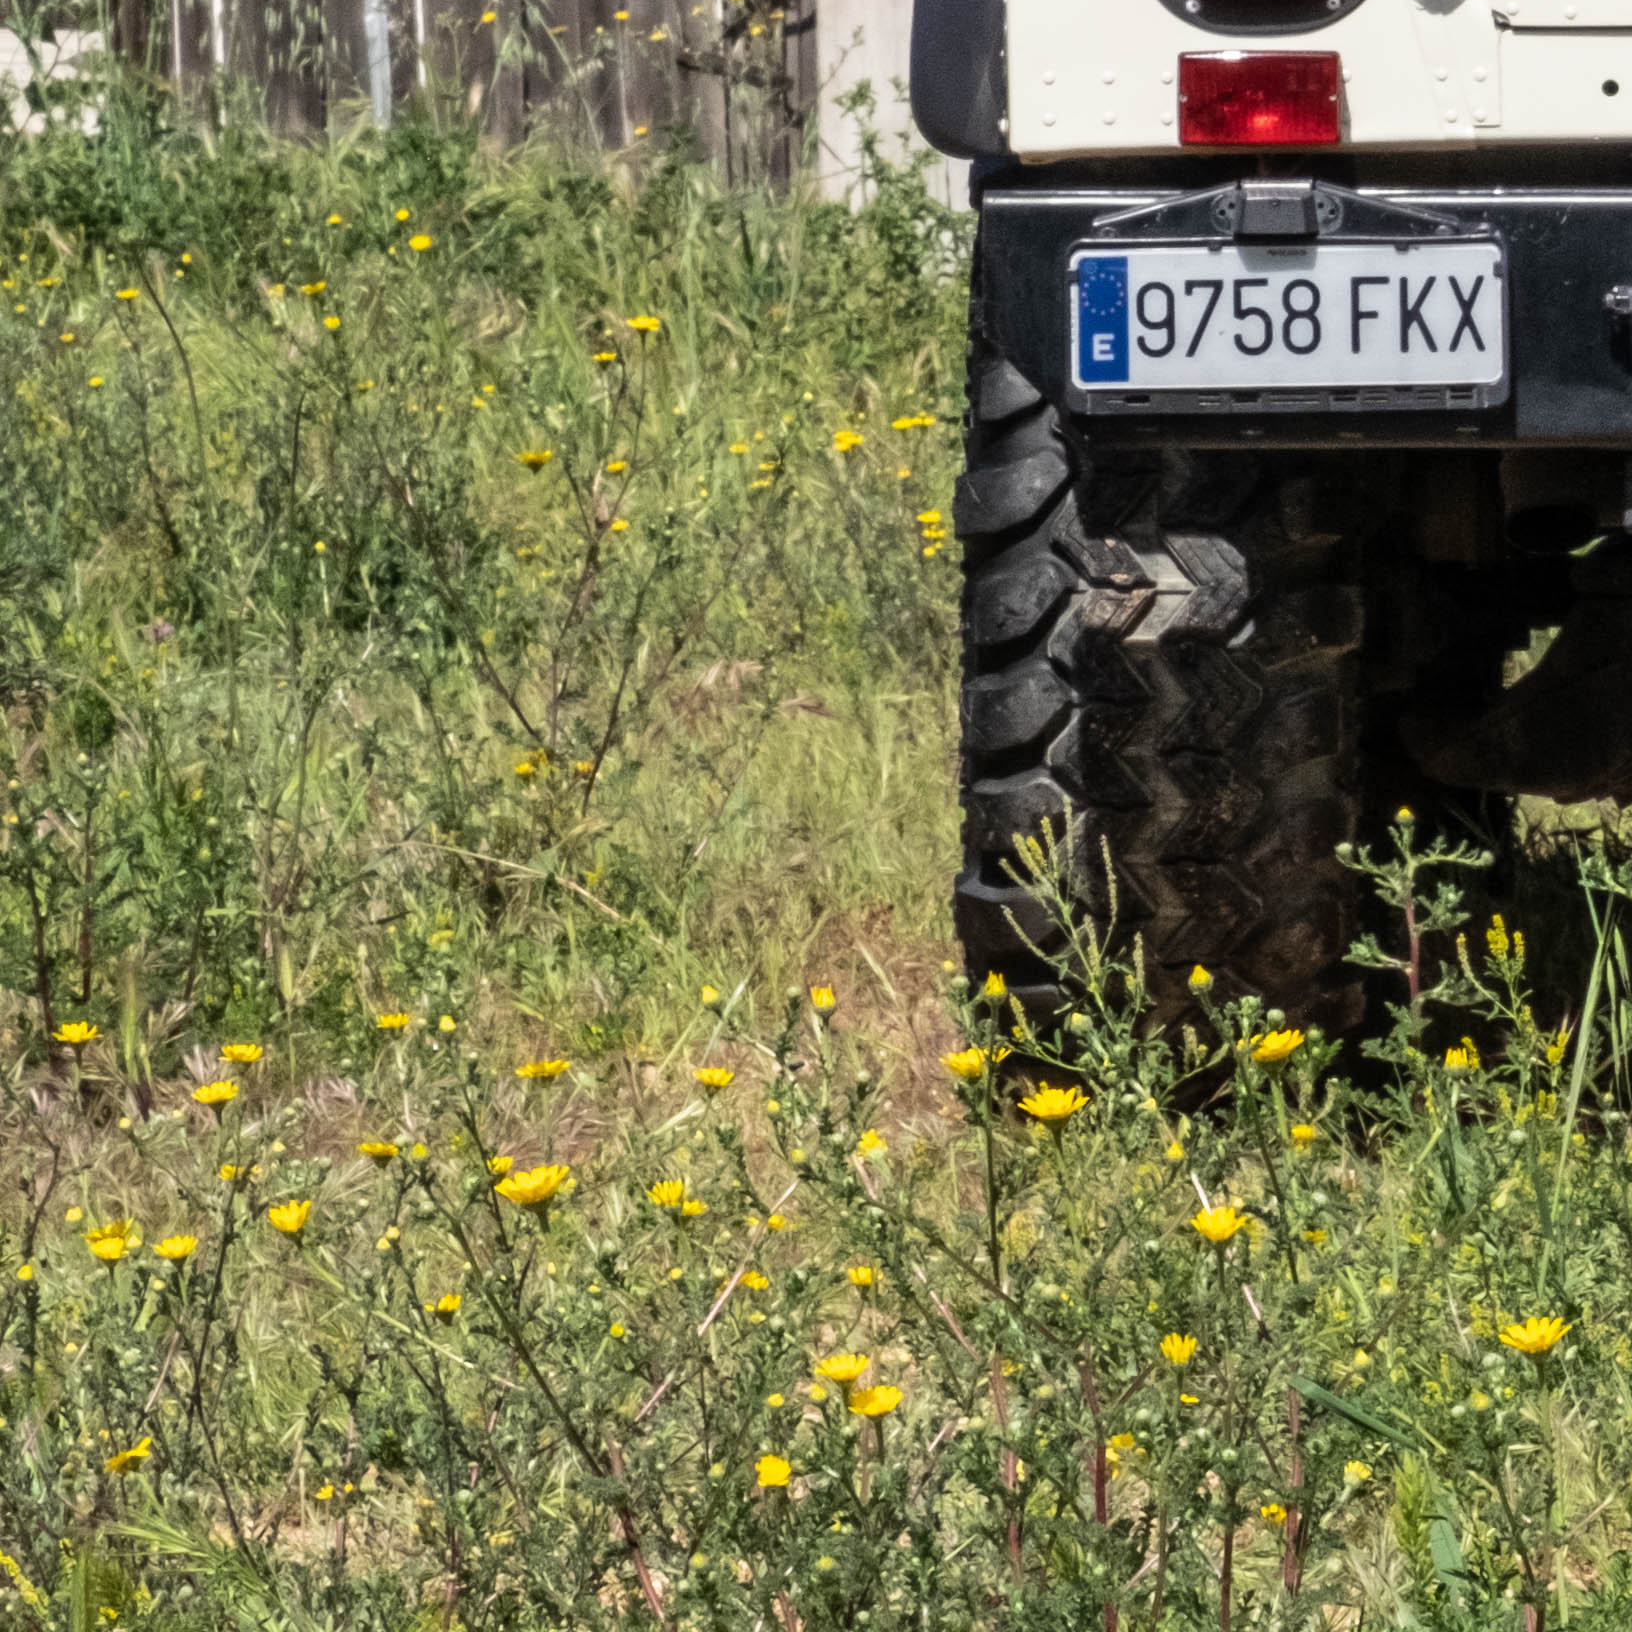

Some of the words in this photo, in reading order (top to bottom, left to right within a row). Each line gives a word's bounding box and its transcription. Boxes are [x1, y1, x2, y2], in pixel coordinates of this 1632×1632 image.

[1136, 279, 1321, 358] 9758
[1351, 275, 1486, 354] FKX
[1092, 333, 1115, 361] E
